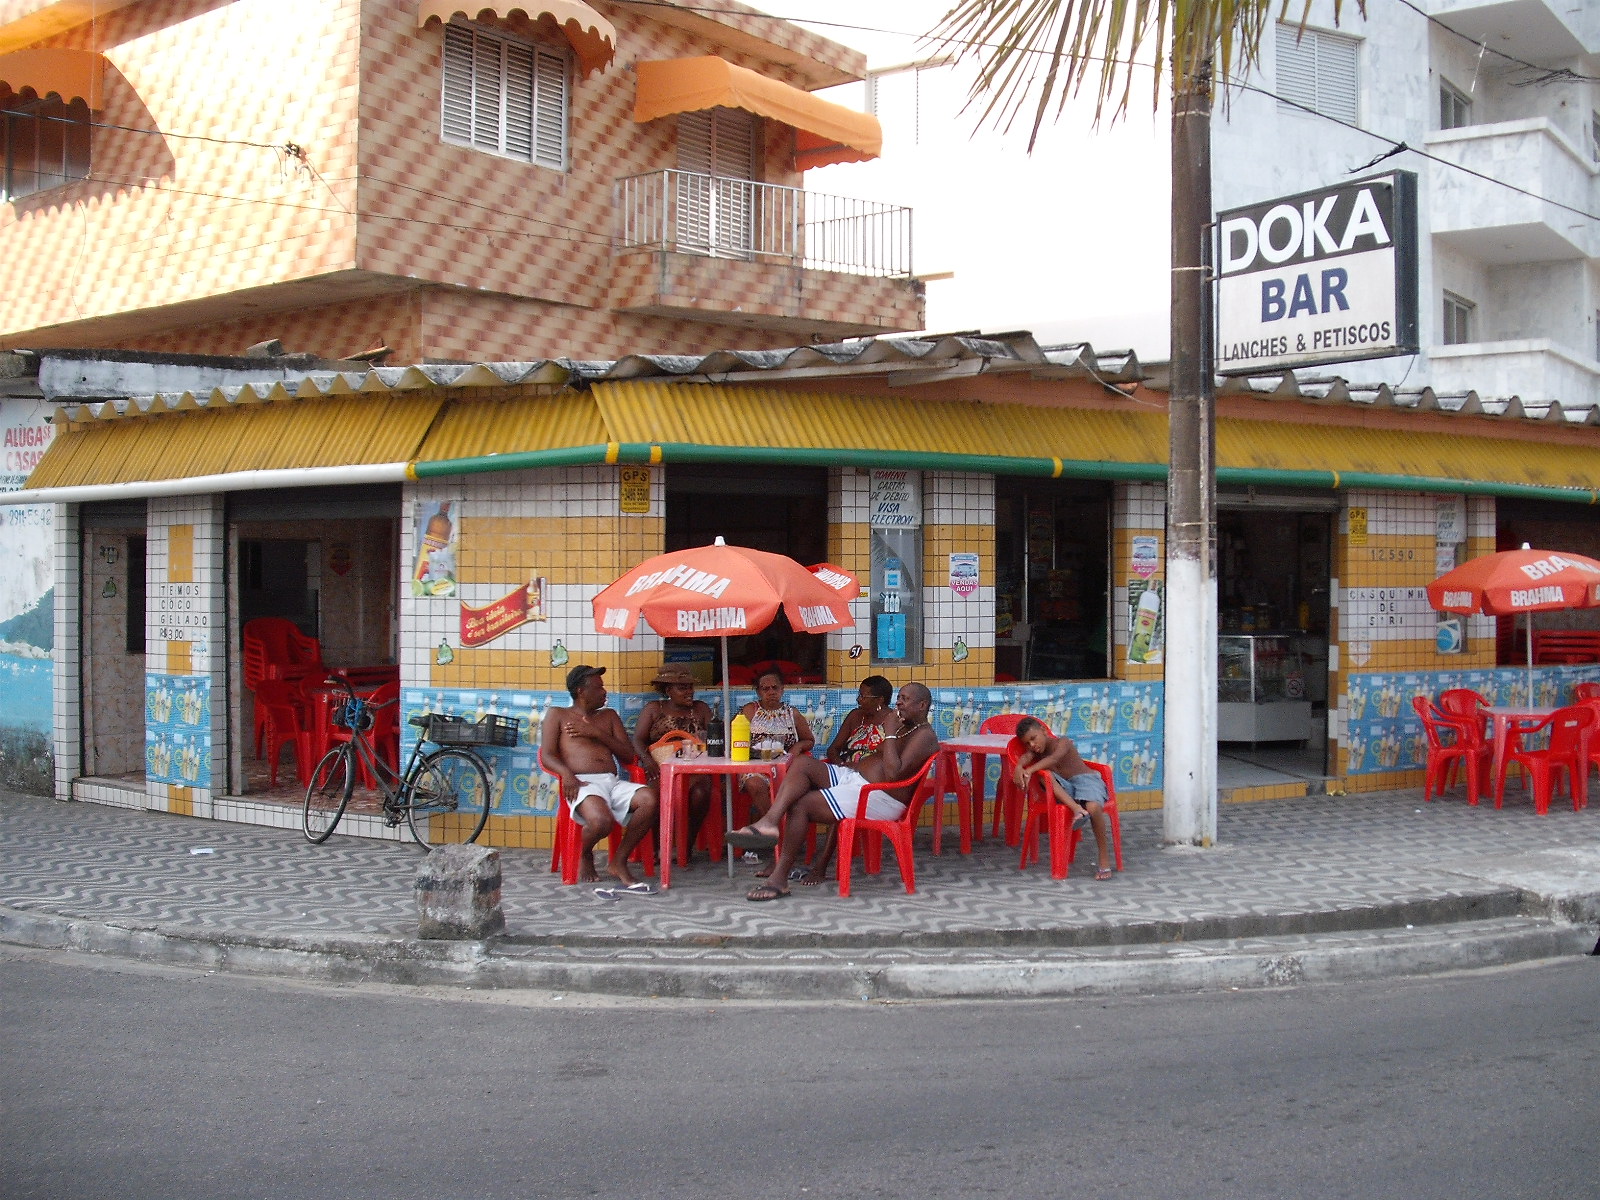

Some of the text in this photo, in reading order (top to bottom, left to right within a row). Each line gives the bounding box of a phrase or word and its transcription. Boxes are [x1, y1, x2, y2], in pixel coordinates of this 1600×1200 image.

[1220, 188, 1391, 275] DOKA
[1261, 267, 1350, 323] BAR
[1223, 321, 1391, 362] LANCHES & PETISCOS
[4, 426, 43, 448] ALUGA
[623, 470, 648, 481] GPS
[877, 502, 900, 513] VISA
[1349, 511, 1365, 520] GPS
[624, 564, 731, 599] BRAHMA
[160, 585, 200, 596] TEMOS
[1510, 586, 1565, 607] BRAHMA
[1379, 603, 1395, 612] DE
[160, 614, 207, 626] GELADO
[677, 607, 747, 632] BRAHMA
[798, 605, 839, 628] BRAHMA
[850, 647, 860, 657] 51
[771, 766, 777, 779] 9
